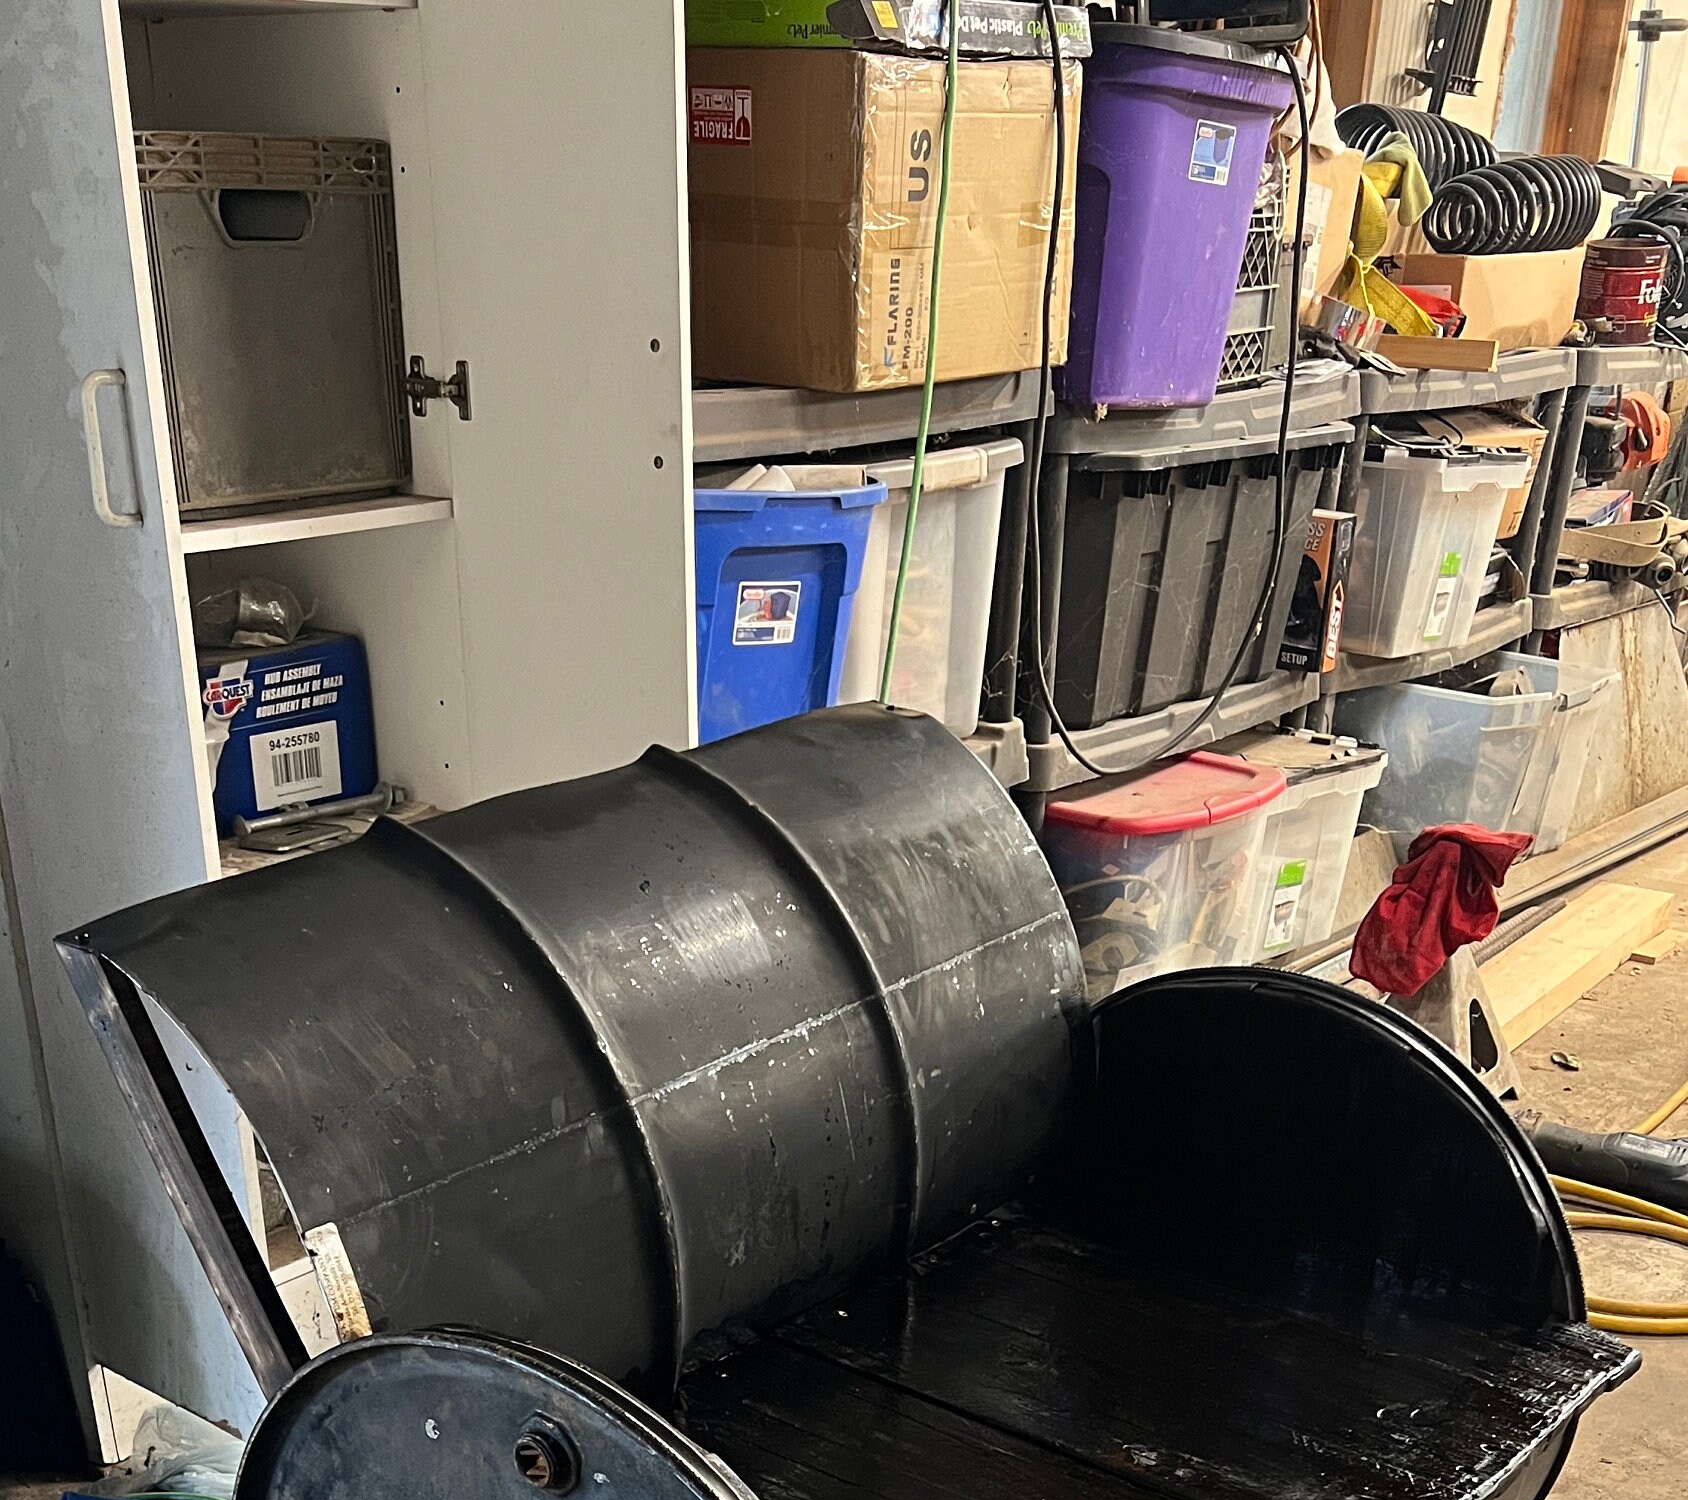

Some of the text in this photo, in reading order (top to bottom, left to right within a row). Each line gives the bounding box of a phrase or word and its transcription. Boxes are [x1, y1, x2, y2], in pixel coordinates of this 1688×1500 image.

[969, 16, 988, 34] Pet
[989, 18, 1023, 37] Plastic
[693, 120, 733, 139] FRAGILE
[908, 128, 932, 202] US
[902, 306, 914, 370] FM-200
[1281, 652, 1308, 666] SETUP
[283, 664, 321, 683] ASSEMBLY
[205, 683, 251, 703] CARQUEST
[261, 675, 344, 702] ENSAMBLAJE DE MAZA
[256, 700, 300, 719] ROULEMENT
[302, 698, 311, 710] DE
[269, 731, 320, 751] 94-255780
